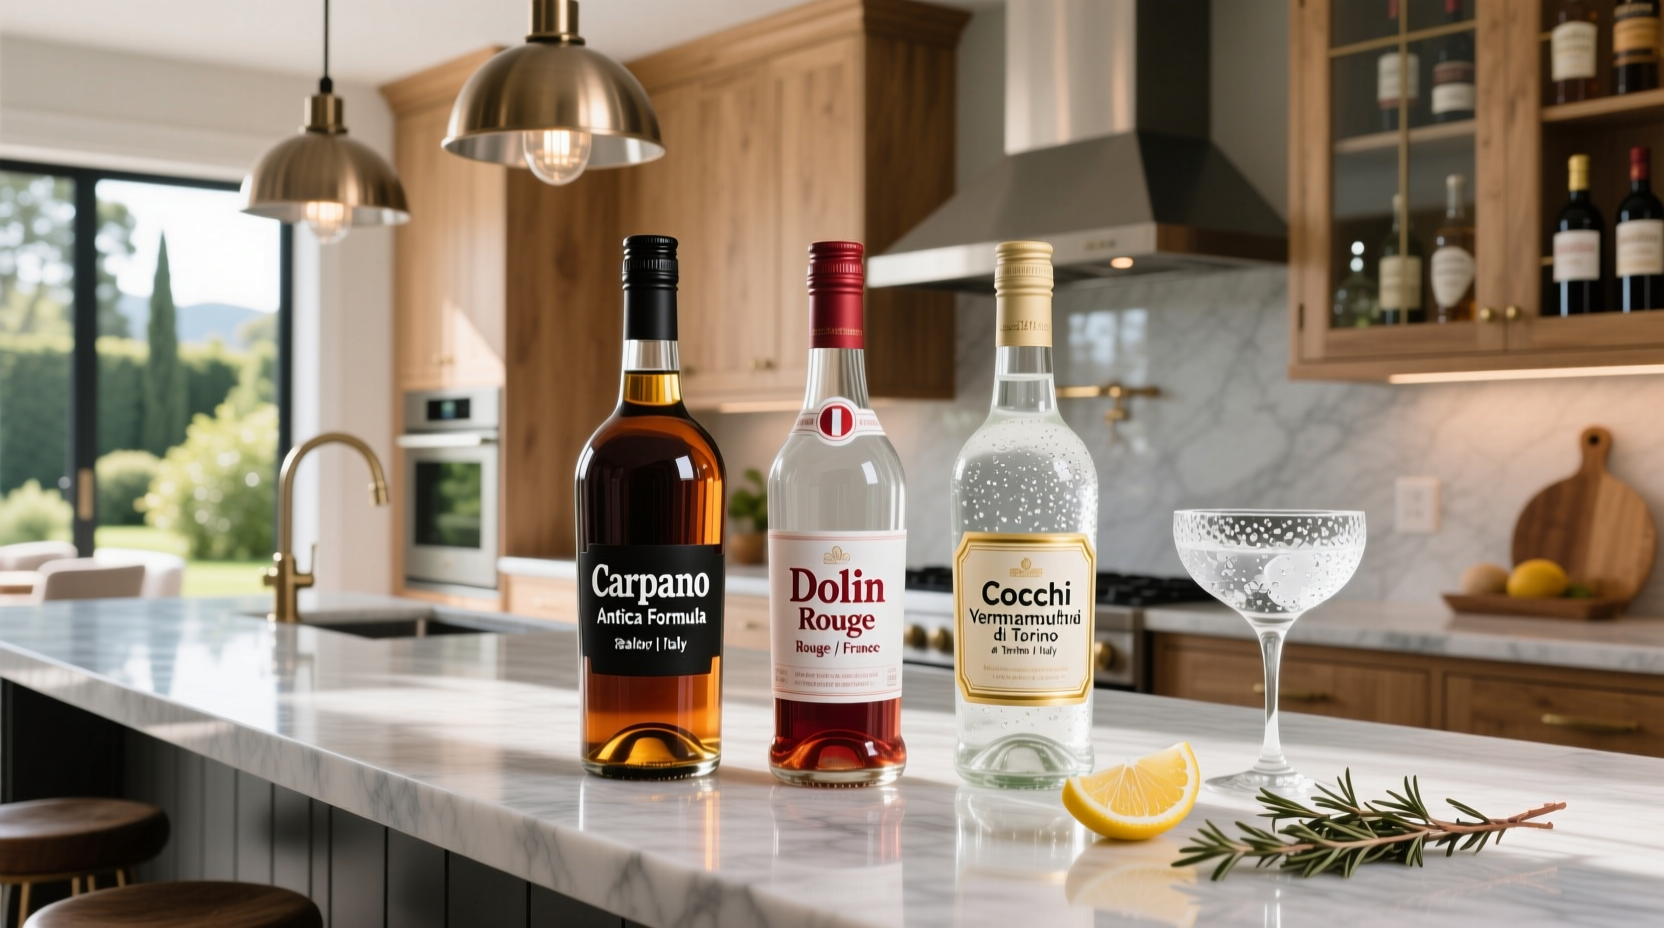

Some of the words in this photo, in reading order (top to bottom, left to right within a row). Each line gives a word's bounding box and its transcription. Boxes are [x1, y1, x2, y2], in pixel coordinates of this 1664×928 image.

[591, 563, 710, 606] Carpano
[789, 567, 886, 604] Dolin
[981, 580, 1071, 607] Cocchi
[597, 607, 643, 625] Antica
[647, 607, 707, 625] Formula
[798, 606, 876, 639] Rouge
[1011, 627, 1059, 642] Torino
[796, 640, 831, 658] Rouge
